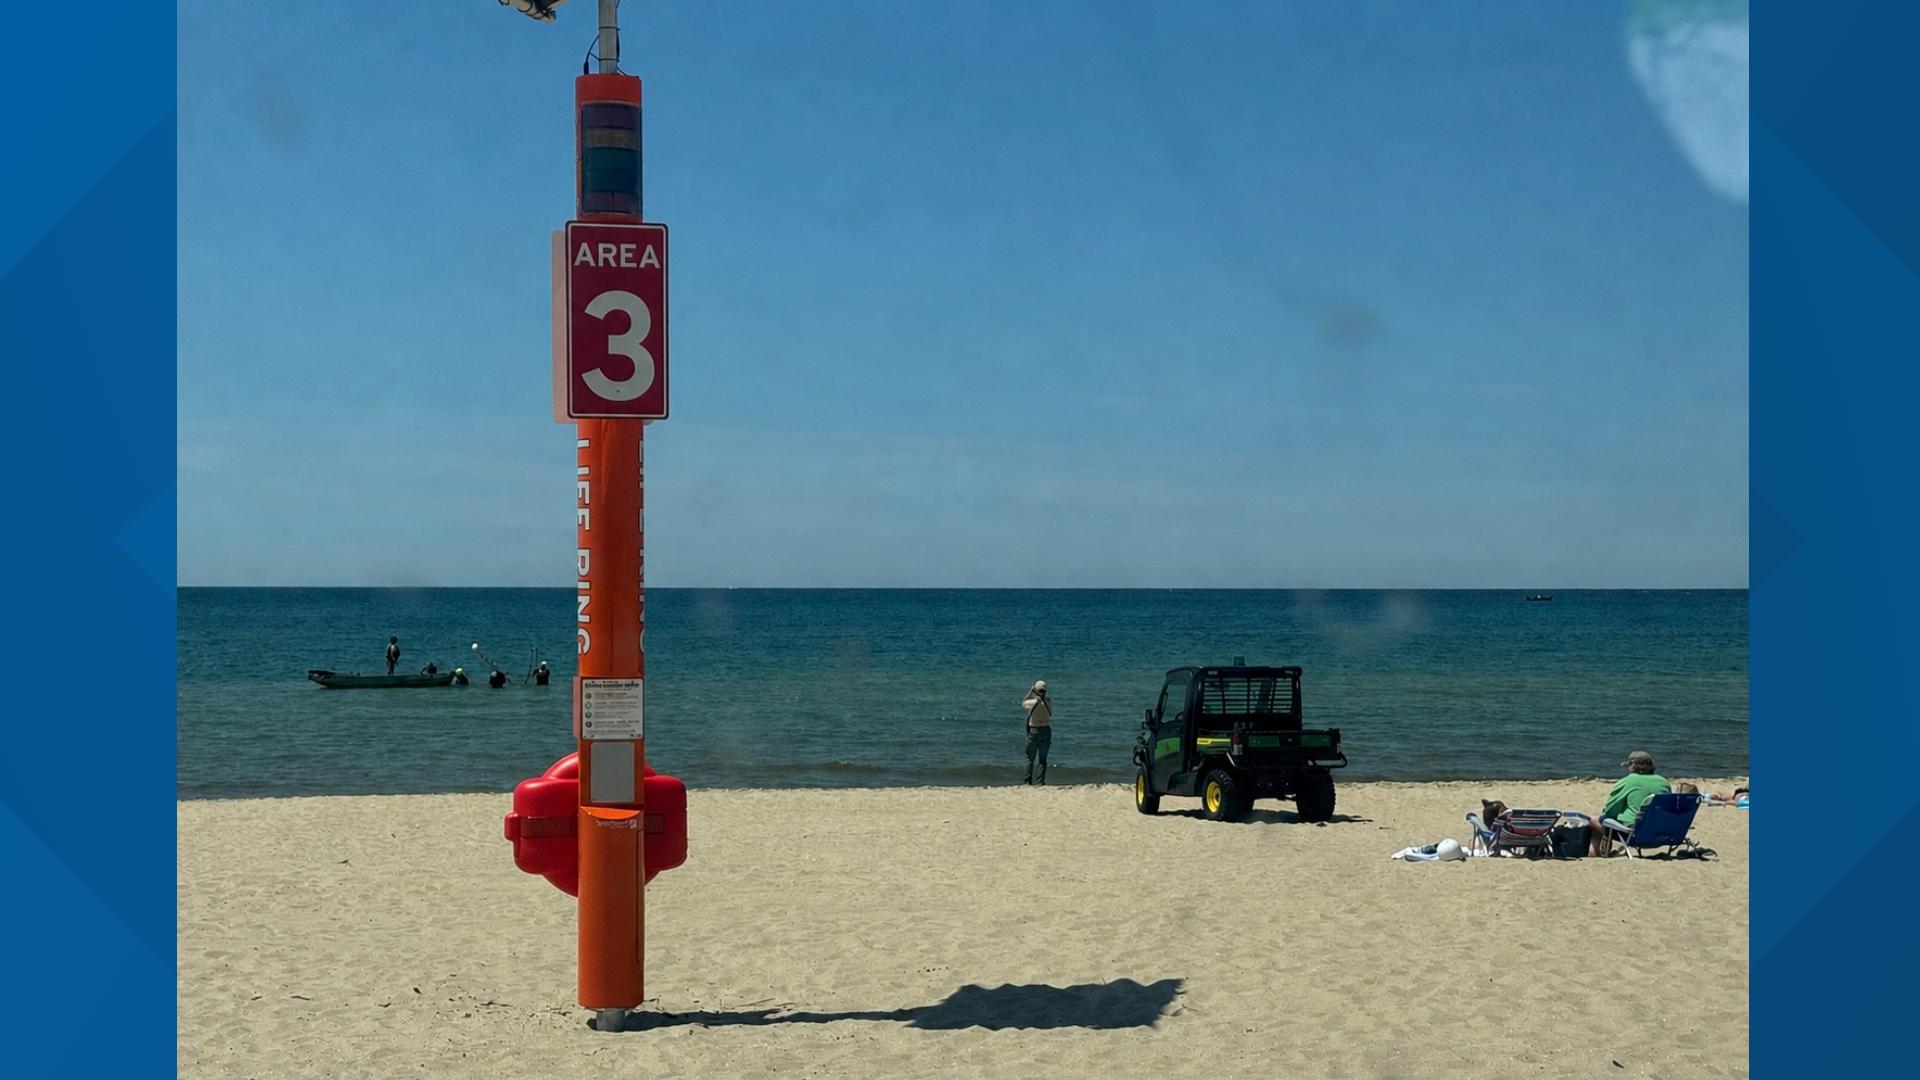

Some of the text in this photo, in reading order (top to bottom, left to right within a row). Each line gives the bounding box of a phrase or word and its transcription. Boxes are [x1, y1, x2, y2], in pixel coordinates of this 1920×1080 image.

[573, 242, 661, 269] AREA
[581, 290, 655, 402] 3
[577, 548, 591, 656] RING
